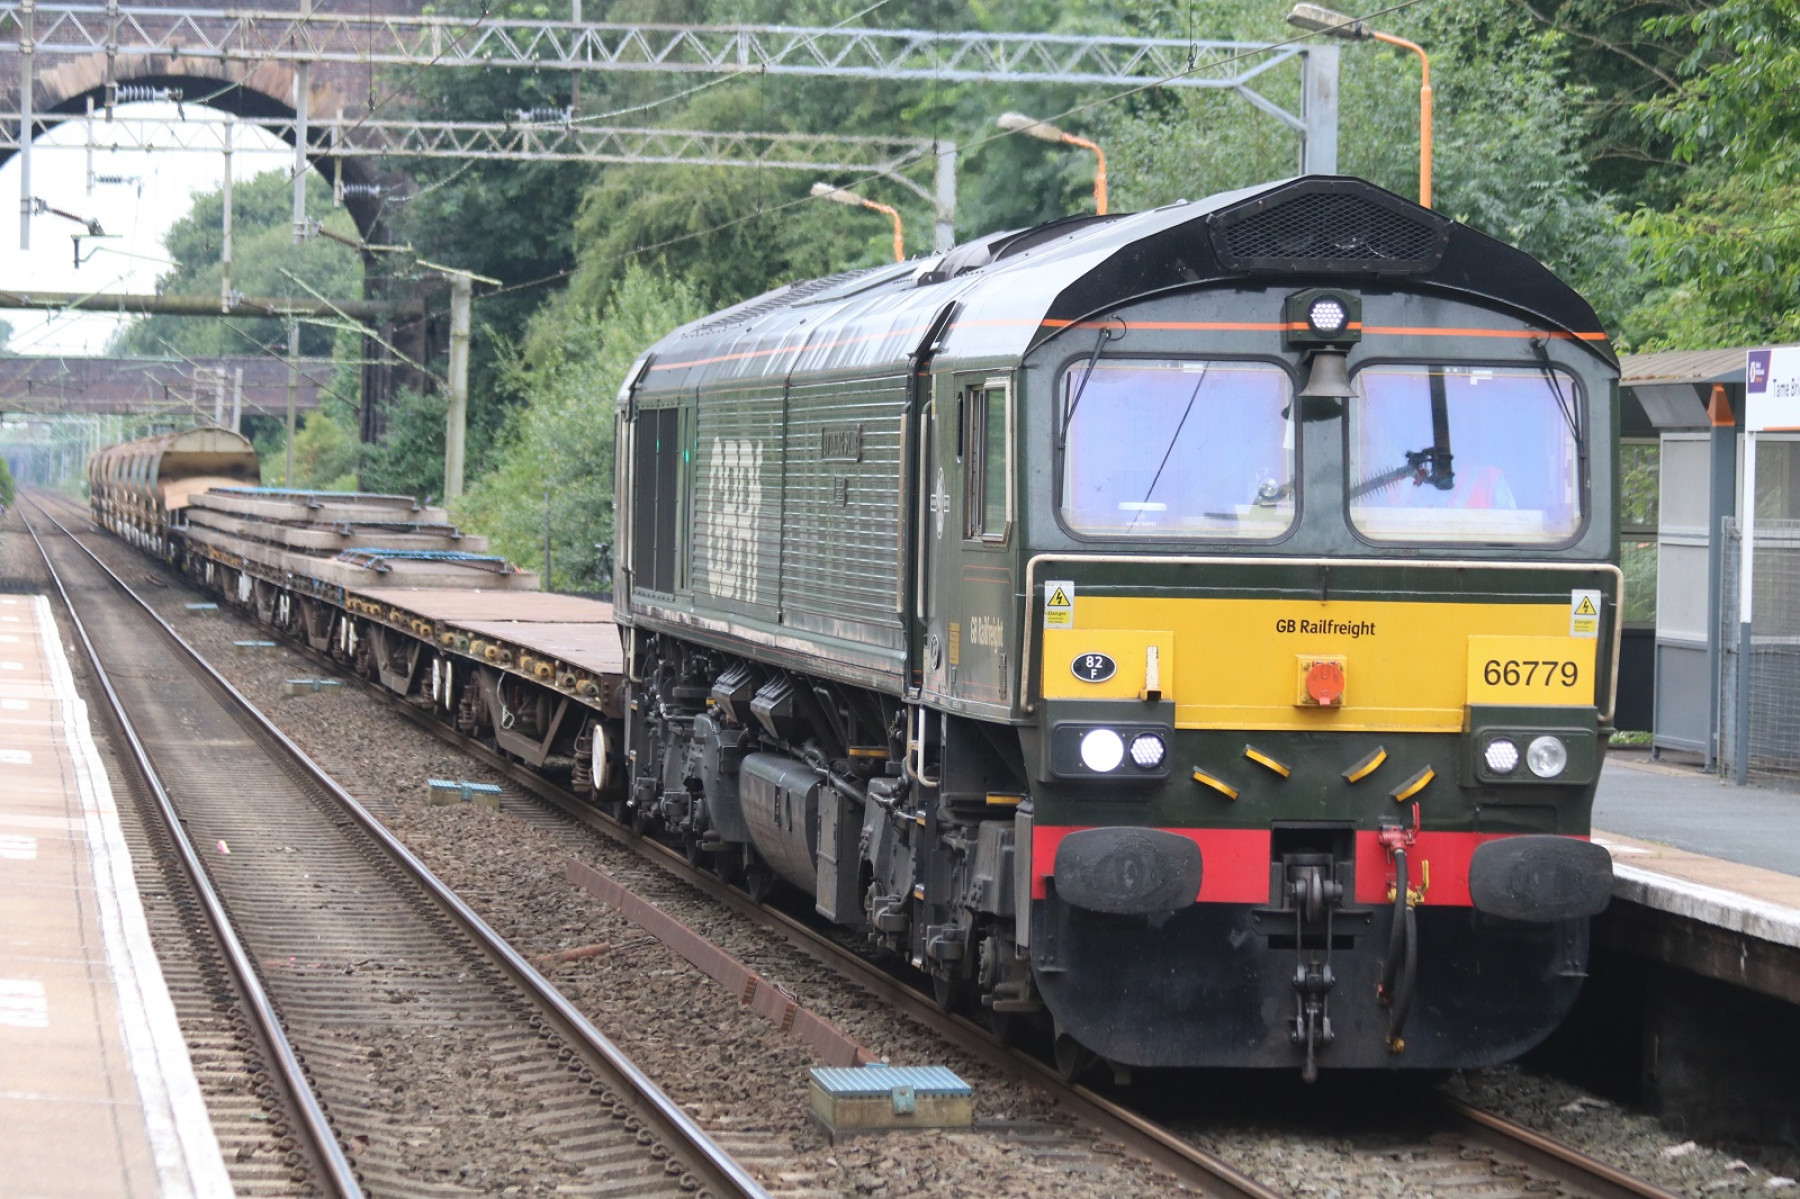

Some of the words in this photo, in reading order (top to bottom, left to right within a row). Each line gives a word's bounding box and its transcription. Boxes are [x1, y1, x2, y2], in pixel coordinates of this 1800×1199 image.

[1276, 619, 1296, 633] GB
[1300, 619, 1376, 638] Railfreight
[1086, 656, 1103, 668] 82
[1090, 669, 1097, 679] F
[1484, 659, 1578, 687] 66779
